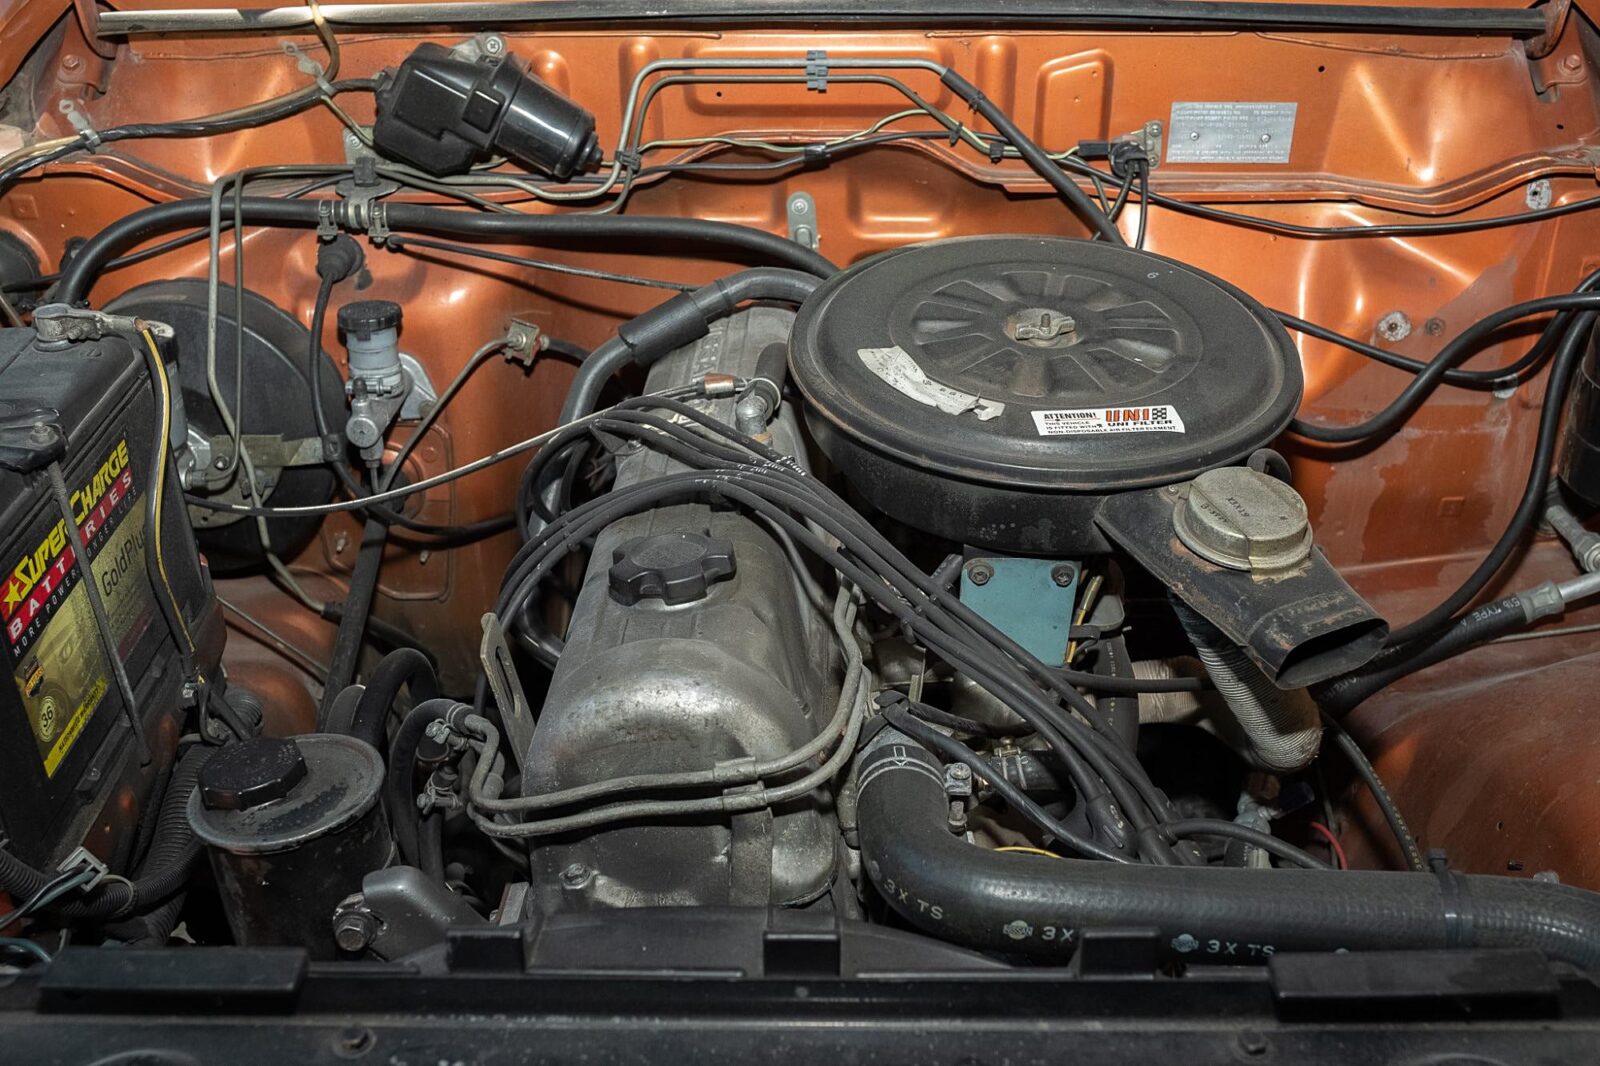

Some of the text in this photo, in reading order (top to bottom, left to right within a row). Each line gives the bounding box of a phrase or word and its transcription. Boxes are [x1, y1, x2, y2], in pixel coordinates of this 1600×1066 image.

[1044, 412, 1097, 420] ATTENTION!
[1105, 408, 1149, 422] UNI
[10, 471, 132, 640] BATTRIES
[101, 524, 147, 597] GoldPlu
[14, 617, 41, 657] MORE
[86, 516, 115, 554] ONGER
[1472, 607, 1502, 622] TYPE
[41, 705, 54, 728] 36
[916, 898, 944, 920] TS
[1247, 943, 1276, 957] TS
